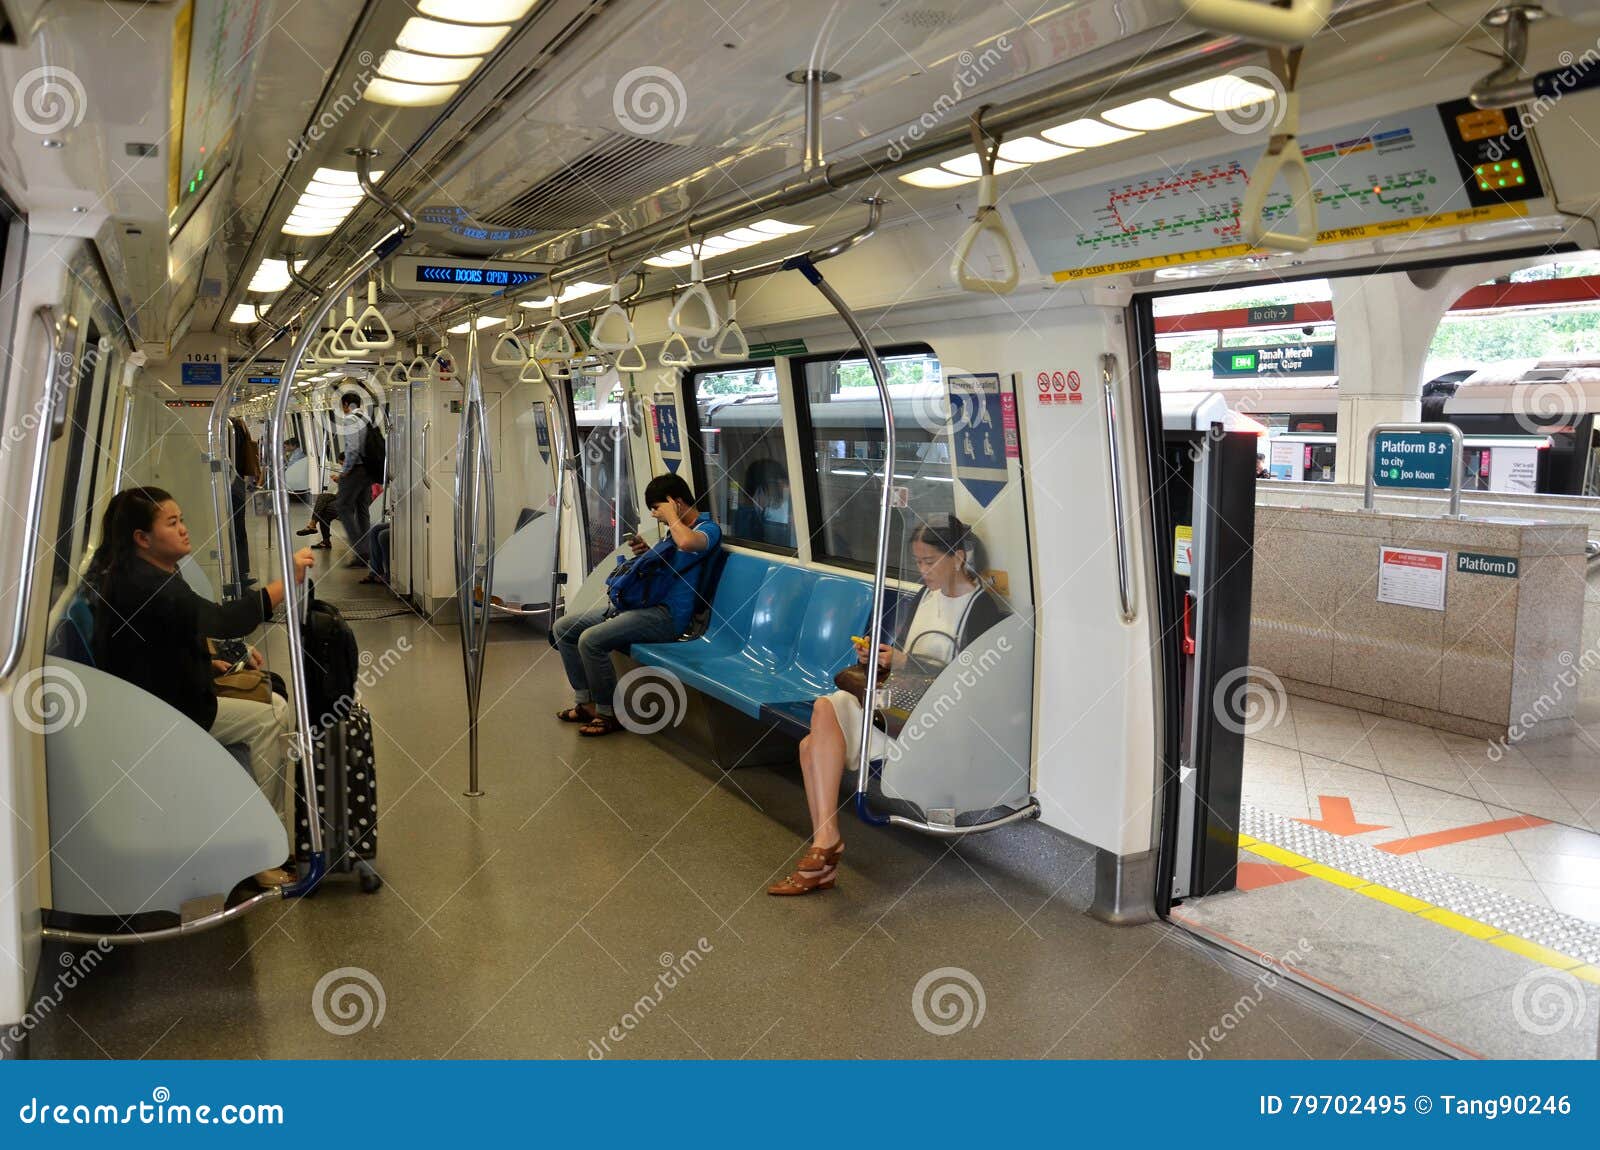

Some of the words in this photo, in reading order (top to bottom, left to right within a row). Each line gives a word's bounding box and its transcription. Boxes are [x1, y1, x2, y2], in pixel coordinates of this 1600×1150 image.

[1340, 226, 1365, 239] PINTU
[1118, 260, 1141, 271] DOORS
[455, 269, 482, 282] DOORS
[486, 271, 508, 284] OPEN
[1254, 310, 1262, 320] to
[1264, 308, 1278, 321] city
[187, 353, 218, 362] 1041
[1258, 347, 1284, 360] Tanah
[1284, 345, 1313, 359] Merah
[1381, 440, 1425, 454] Platform
[1428, 441, 1436, 454] B
[1381, 457, 1389, 466] to
[1390, 456, 1404, 467] city
[1380, 469, 1388, 478] to
[1400, 470, 1414, 480] Joo
[1415, 470, 1435, 480] Koon
[1459, 556, 1505, 574] Platform
[1507, 562, 1516, 574] D
